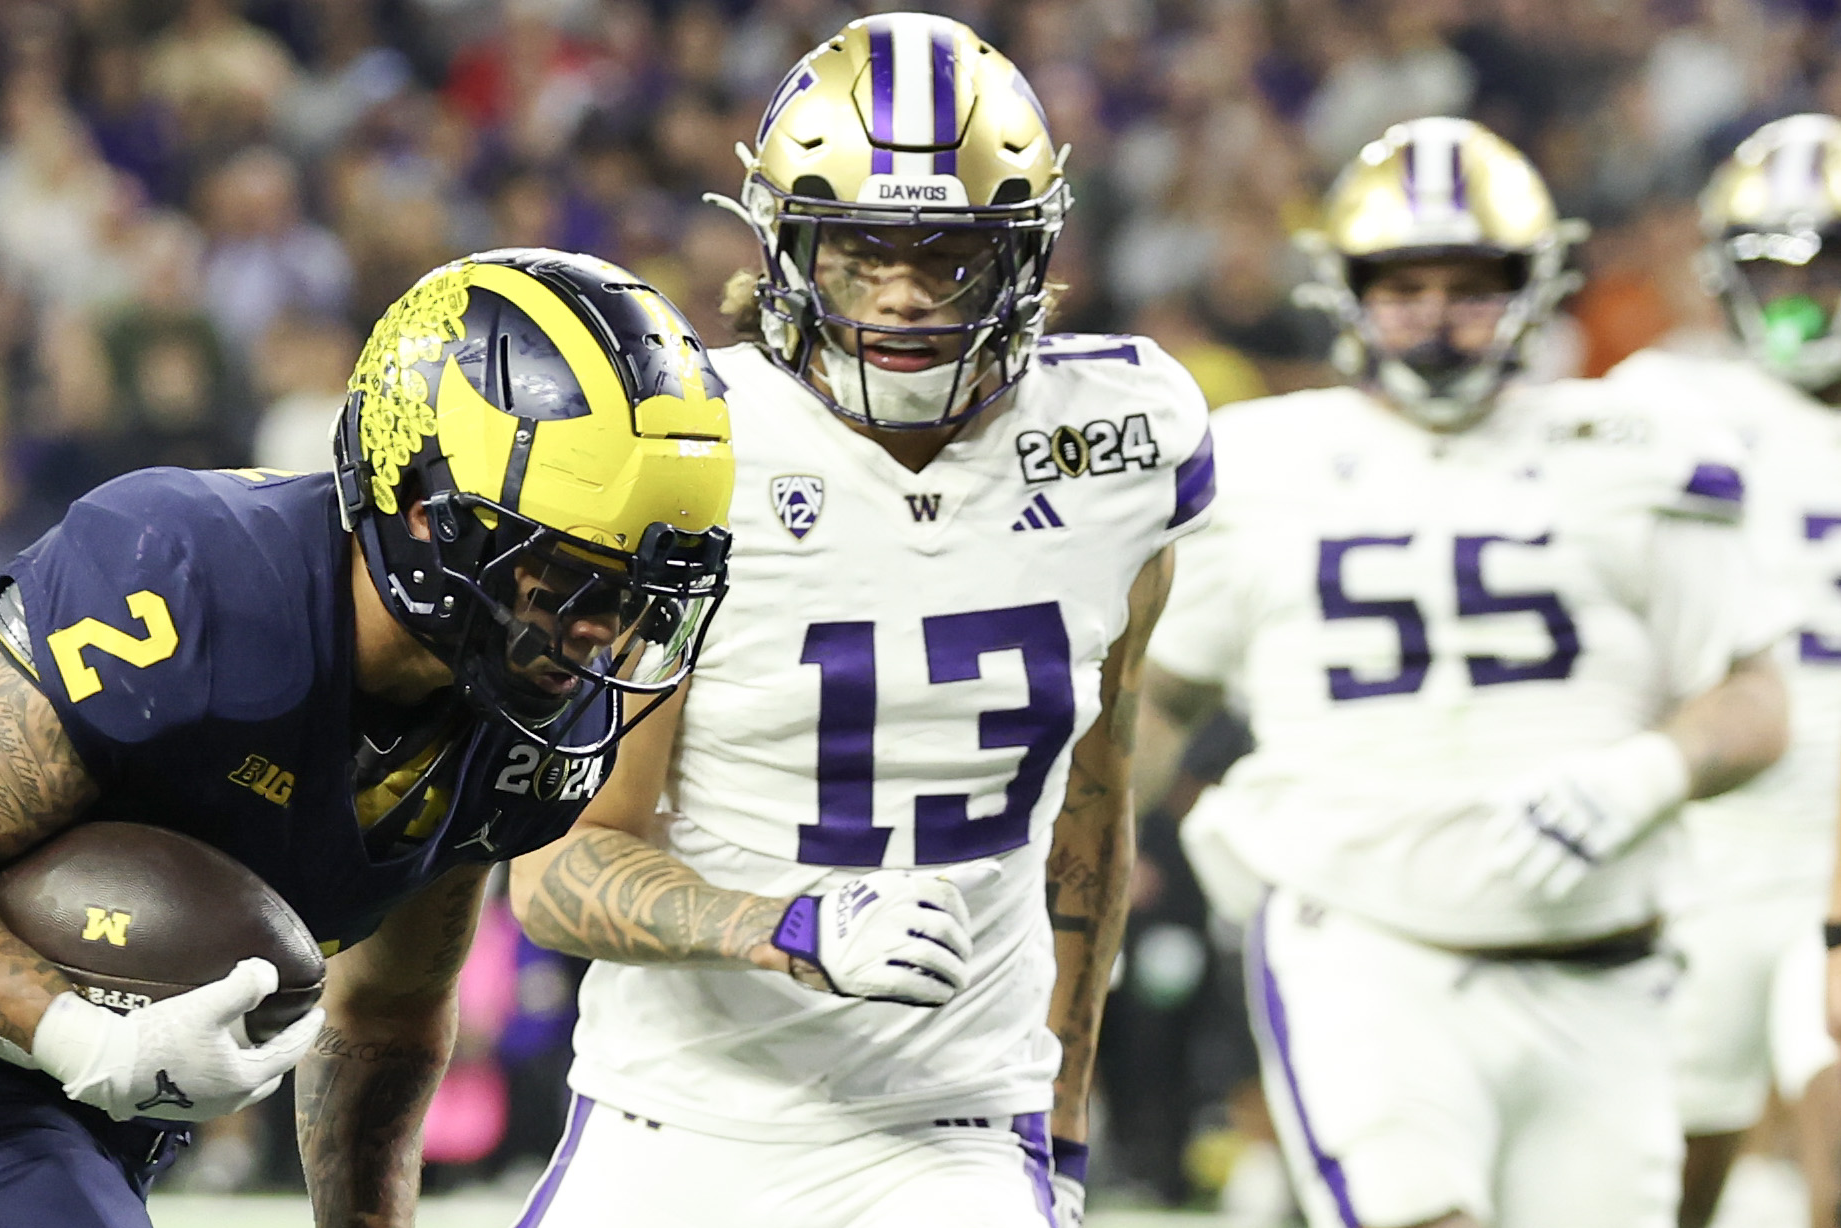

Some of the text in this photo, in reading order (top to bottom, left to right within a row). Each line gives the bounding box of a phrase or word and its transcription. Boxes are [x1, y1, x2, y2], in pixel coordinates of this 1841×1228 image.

[879, 183, 947, 201] DAWGS
[903, 493, 943, 523] W
[46, 590, 179, 704] 2
[1316, 533, 1582, 702] 55
[797, 600, 1075, 867] 13
[81, 907, 133, 948] M
